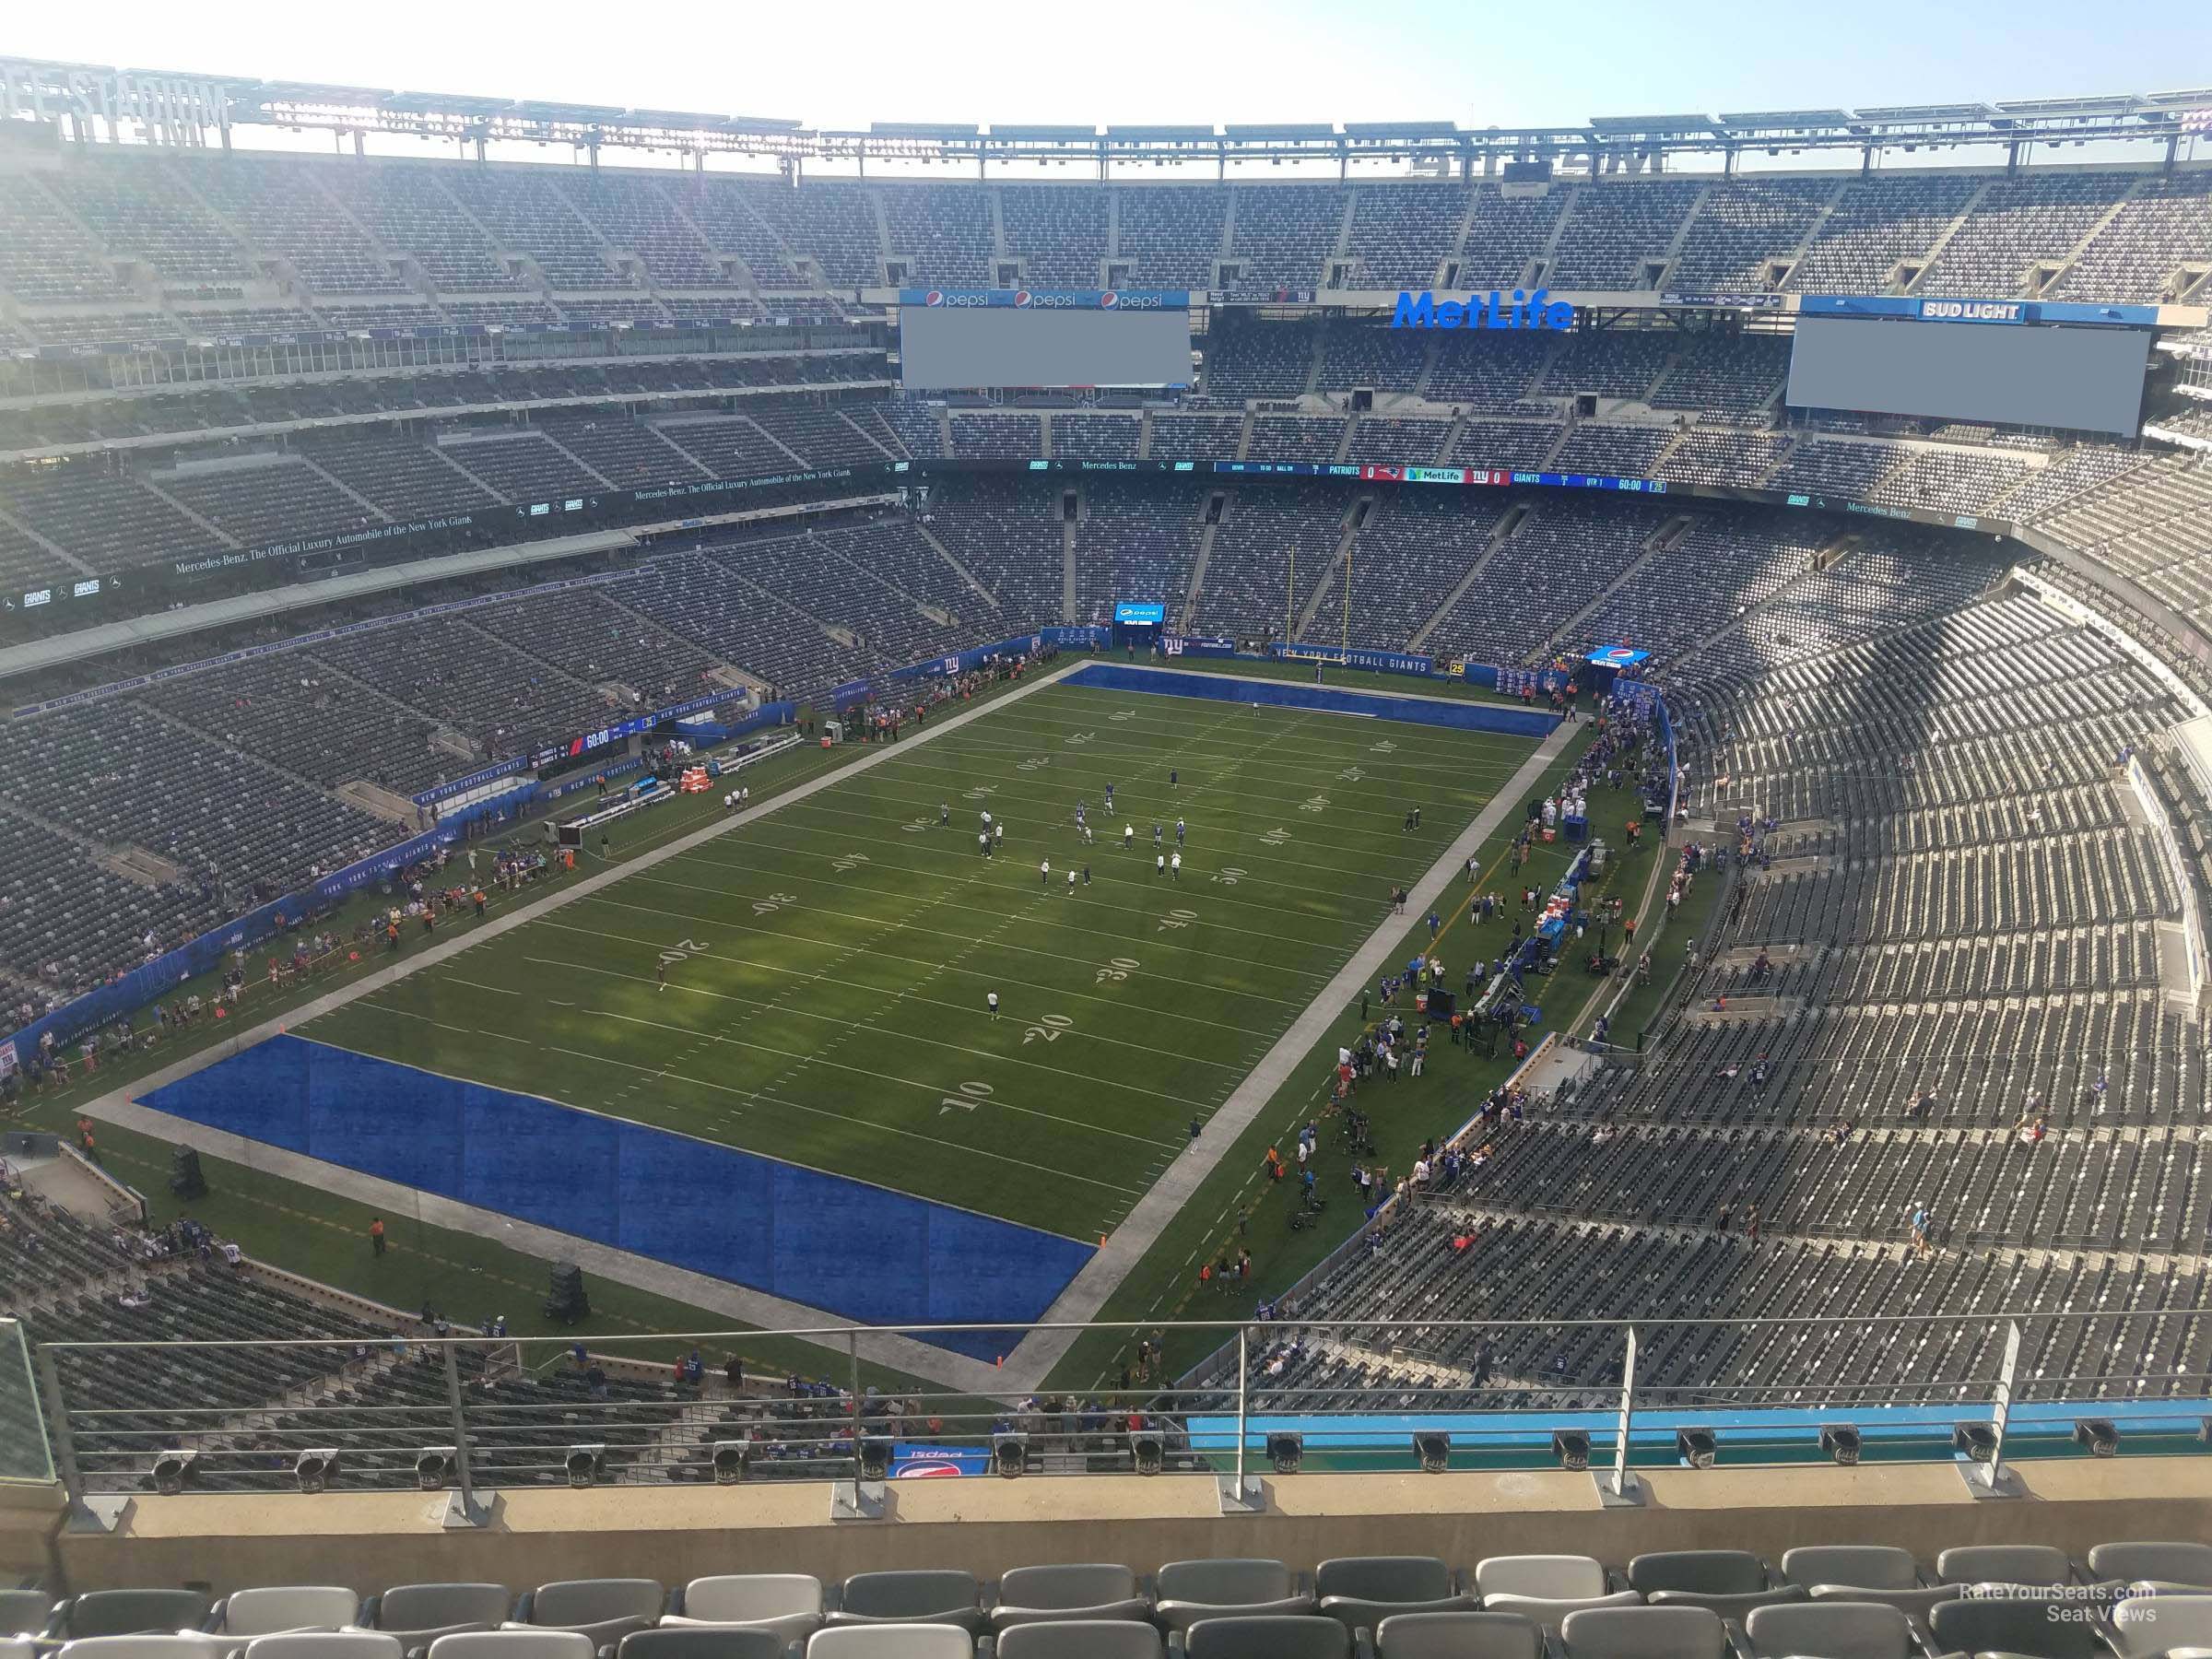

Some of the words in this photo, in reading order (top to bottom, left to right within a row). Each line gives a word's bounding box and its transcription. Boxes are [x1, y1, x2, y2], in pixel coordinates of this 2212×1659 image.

[69, 72, 231, 129] STADIUM
[947, 294, 988, 308] pepsi
[1033, 294, 1076, 309] pepsi
[1119, 294, 1161, 310] pepsi
[1391, 288, 1574, 328] MetLife
[1923, 301, 1962, 317] BUD
[1963, 303, 2019, 319] LIGHT
[1082, 461, 1117, 469] Mercedes
[1118, 461, 1136, 469] Benz
[1329, 466, 1359, 475] PATRIOTS
[1367, 466, 1373, 477] 0
[688, 485, 700, 494] The
[701, 482, 724, 492] Official
[725, 479, 747, 489] Luxury
[749, 476, 784, 487] Automobile
[803, 472, 817, 480] New
[818, 470, 832, 479] York
[1423, 471, 1460, 480] MetLife
[1493, 472, 1500, 484] 0
[1513, 473, 1540, 482] GIANTS
[1618, 479, 1641, 490] 60:00
[1847, 502, 1888, 516] Mercedes
[1889, 508, 1912, 519] Benz
[250, 548, 266, 560] The
[268, 542, 300, 557] Official
[302, 538, 333, 552] Luxury
[335, 530, 382, 546] Automobile
[394, 525, 406, 535] the
[408, 522, 427, 532] New
[428, 518, 448, 529] York
[449, 515, 473, 527] Giants
[74, 579, 100, 594] GIANTS
[24, 589, 51, 605] GIANTS
[1389, 658, 1427, 672] GIANTS
[1452, 664, 1464, 673] 25
[586, 729, 608, 748] 60:00
[1370, 741, 1397, 753] 10
[421, 793, 435, 803] NEW
[440, 785, 457, 795] YORK
[461, 771, 493, 789] FOOTBALL
[496, 760, 520, 775] GIANTS
[1335, 768, 1366, 782] 20
[1298, 797, 1331, 812] 30
[1259, 830, 1291, 846] 40
[1210, 867, 1248, 885] 50
[752, 892, 797, 912] 30
[1159, 909, 1198, 928] 40
[659, 938, 710, 961] 20
[1097, 958, 1140, 981] 30
[1025, 1014, 1074, 1041] 20
[942, 1081, 994, 1112] 10
